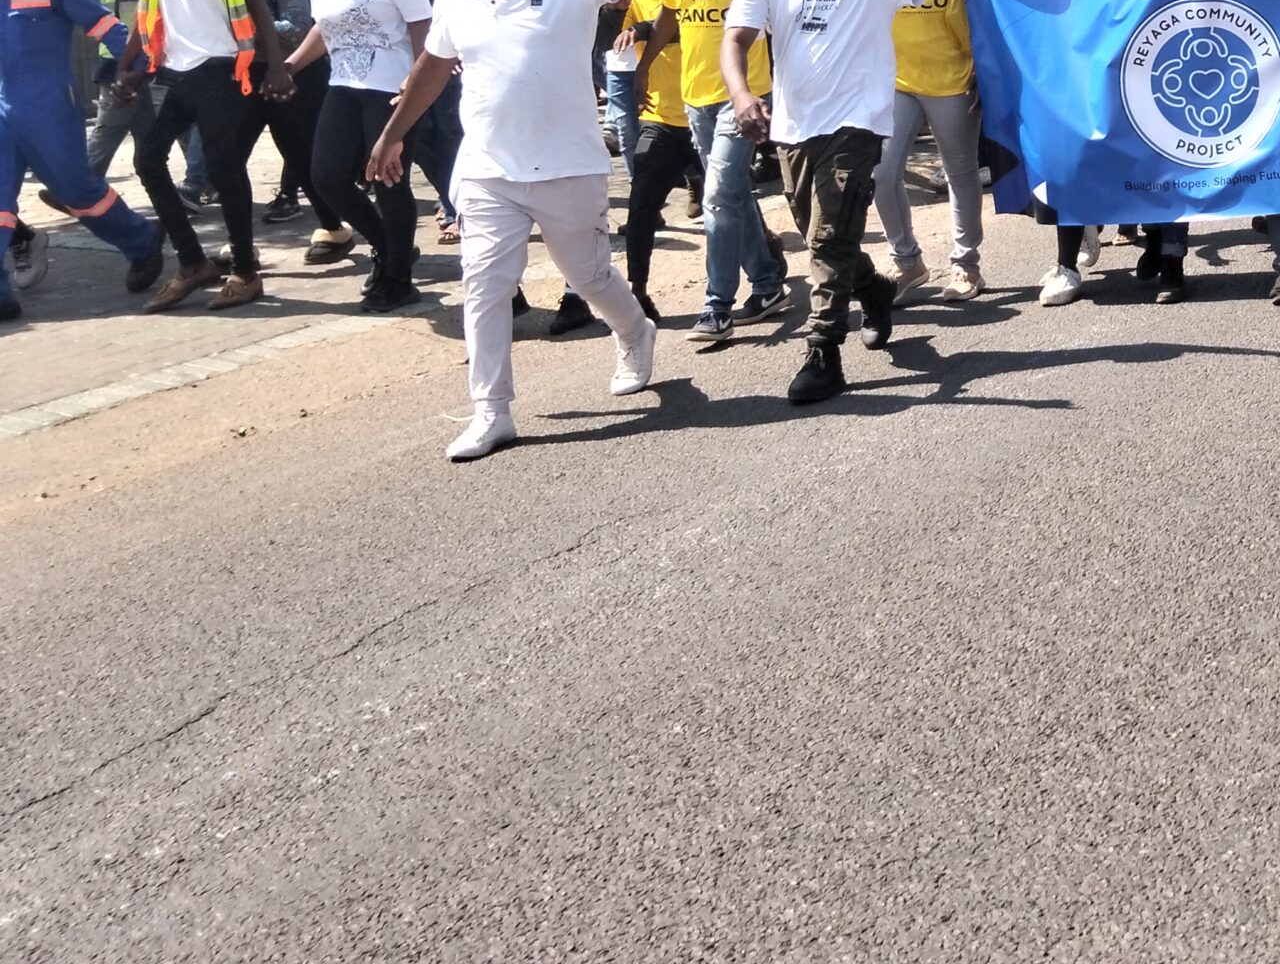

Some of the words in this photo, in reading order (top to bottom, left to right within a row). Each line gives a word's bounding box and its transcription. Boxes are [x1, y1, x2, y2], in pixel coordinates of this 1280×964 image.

[1133, 15, 1181, 67] REYAGA
[1185, 8, 1273, 58] COMMUNITY
[1175, 135, 1243, 158] PROJECT
[1124, 180, 1170, 192] Building
[1213, 172, 1257, 188] Shaping
